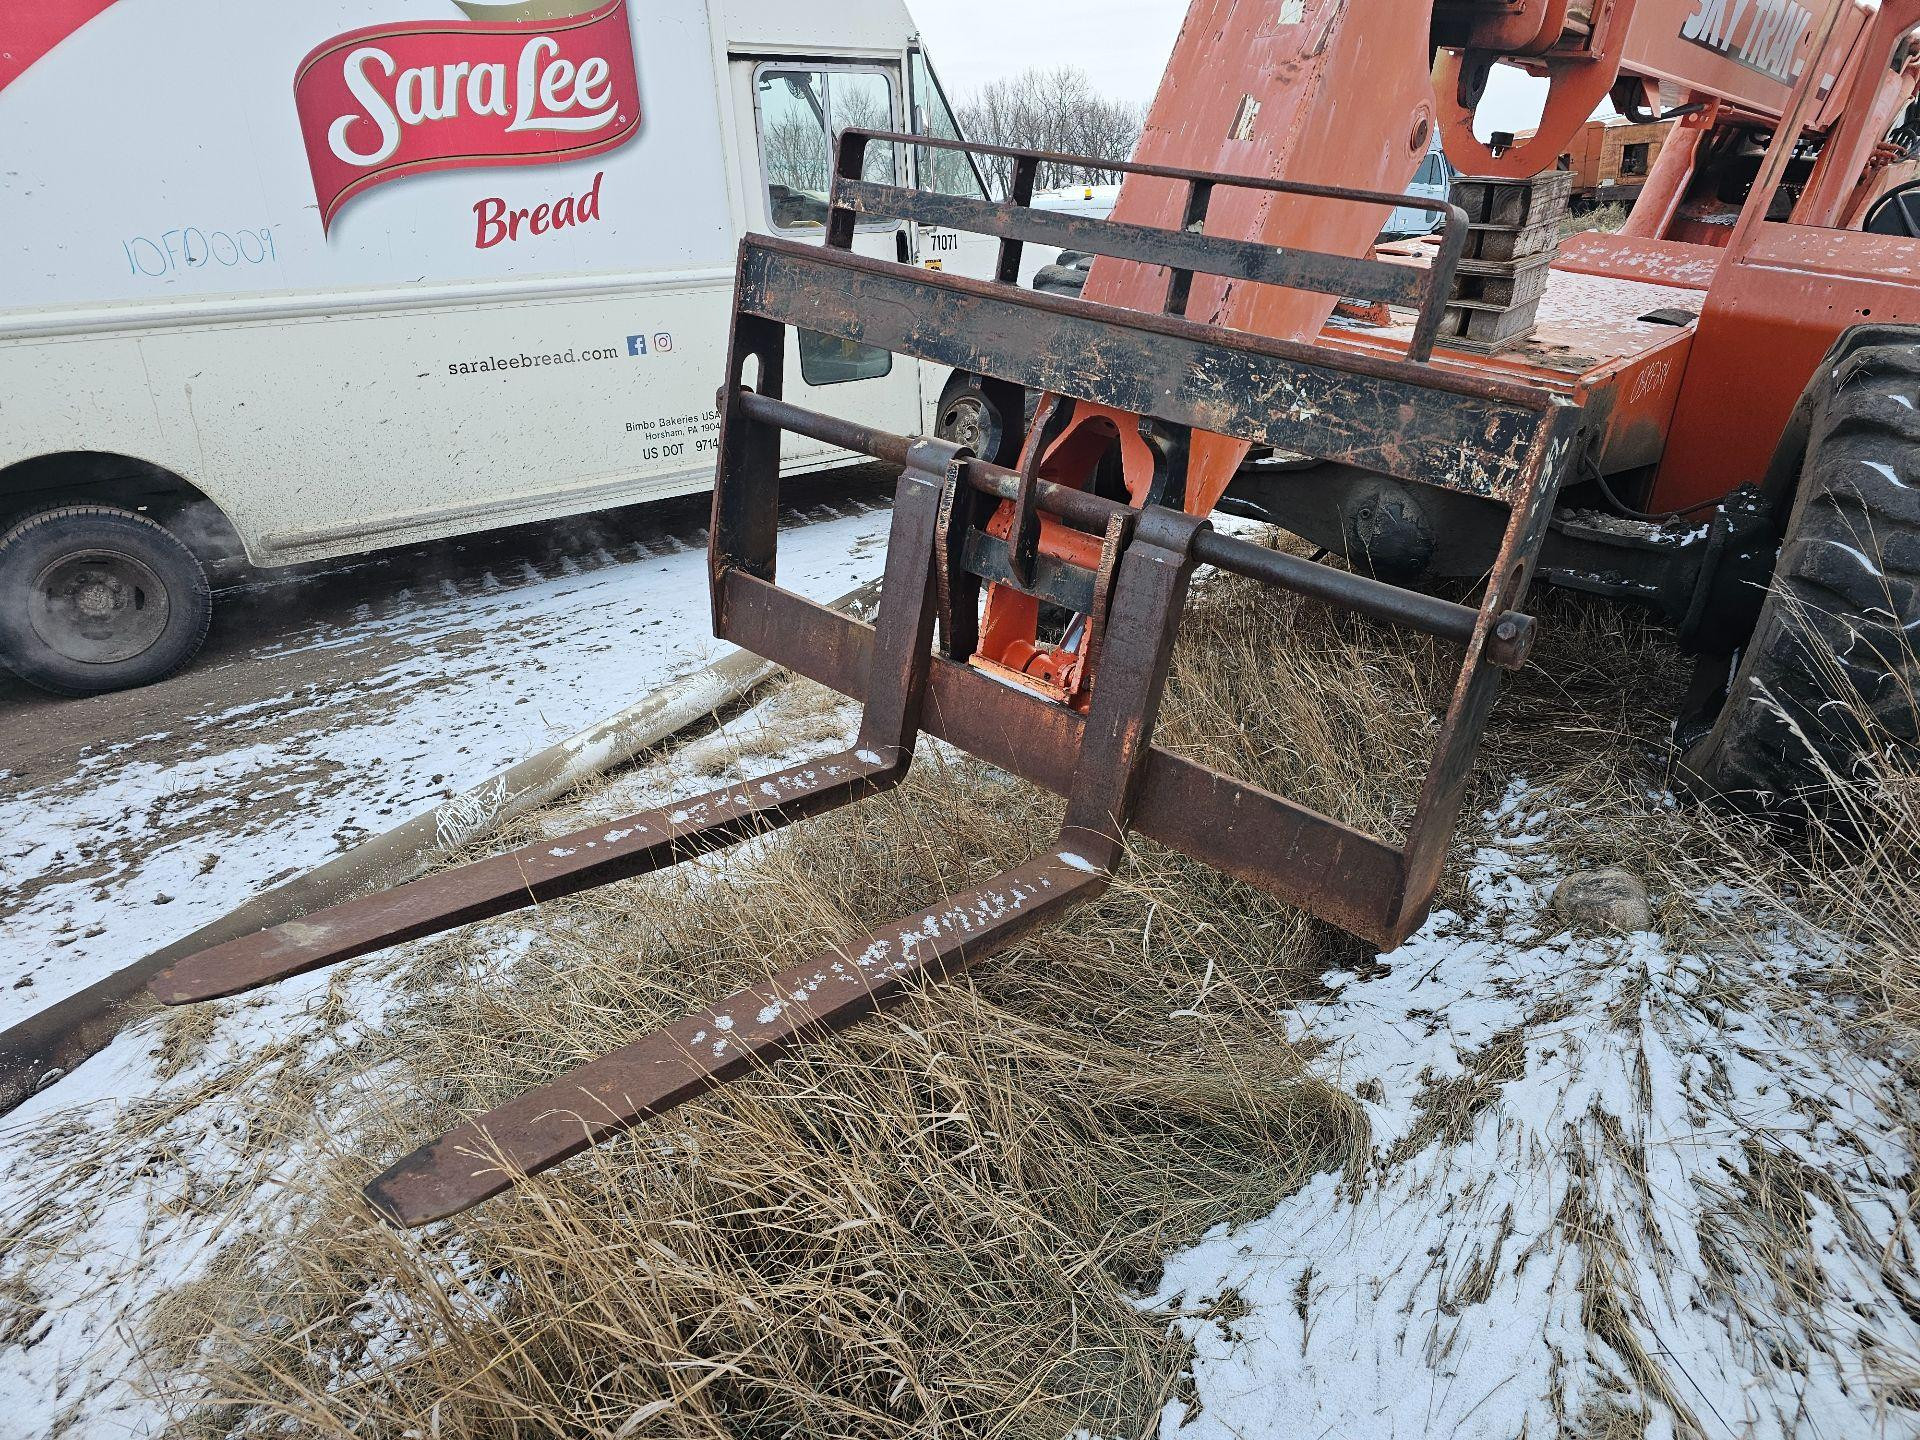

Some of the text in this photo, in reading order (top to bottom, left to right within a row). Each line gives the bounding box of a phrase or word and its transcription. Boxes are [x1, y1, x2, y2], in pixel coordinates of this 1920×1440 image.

[1738, 0, 1812, 79] TRAK
[327, 36, 618, 166] Sara Lee
[472, 172, 603, 249] Bread
[931, 234, 957, 251] 71071
[448, 348, 619, 375] saraleebread.com
[625, 410, 720, 432] Bimbo Bakeries USA
[645, 430, 685, 440] Horsham,
[688, 426, 698, 434] PA
[643, 447, 659, 460] US
[663, 443, 684, 457] DOT
